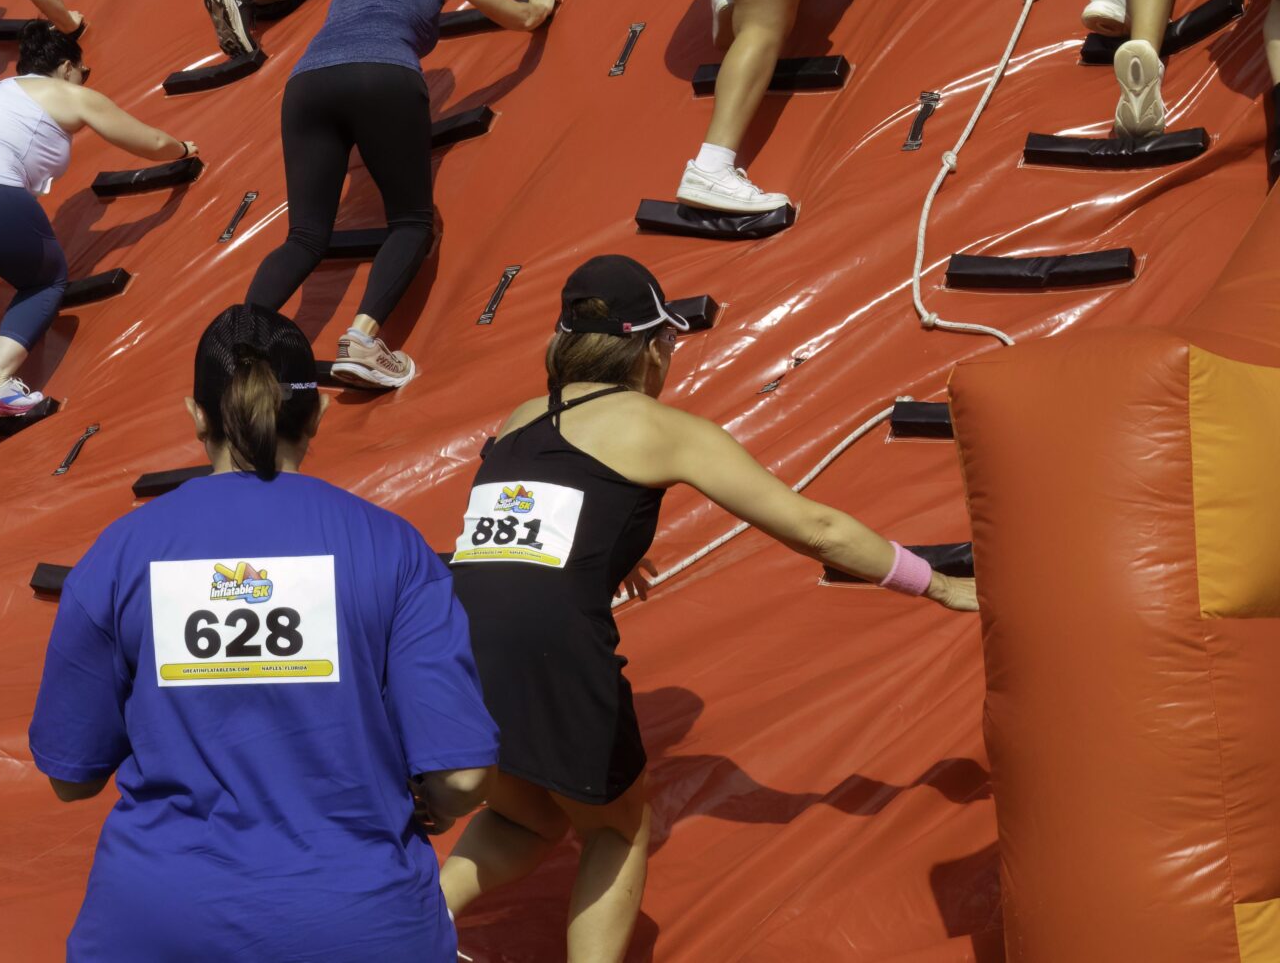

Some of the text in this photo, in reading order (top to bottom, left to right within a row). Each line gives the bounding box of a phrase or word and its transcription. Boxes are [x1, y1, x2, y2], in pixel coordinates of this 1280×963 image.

[471, 515, 543, 550] 881
[211, 585, 270, 598] Inflatable 5K
[216, 580, 237, 589] Great
[184, 607, 304, 659] 628
